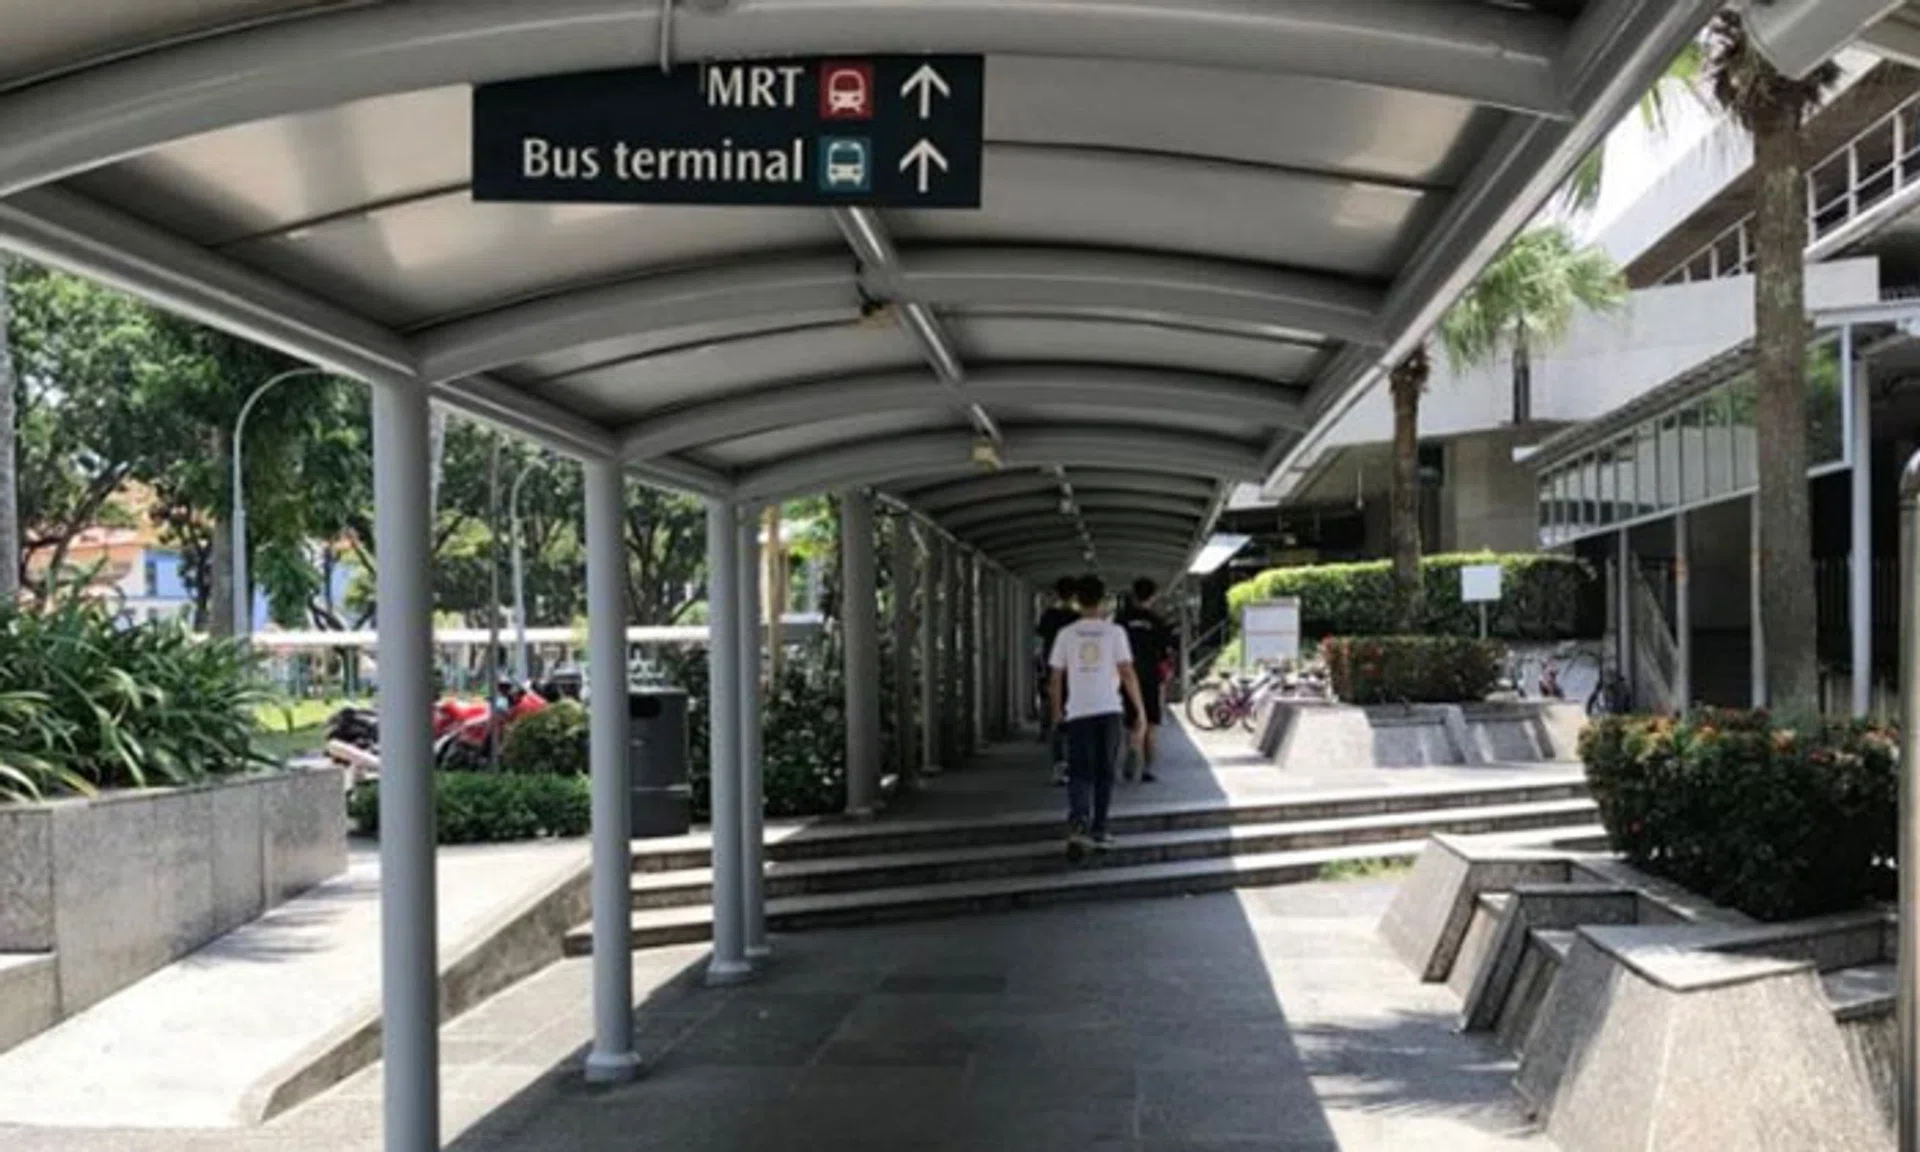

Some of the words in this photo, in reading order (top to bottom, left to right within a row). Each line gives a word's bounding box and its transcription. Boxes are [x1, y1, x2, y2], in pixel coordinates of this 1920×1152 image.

[708, 67, 803, 107] MRT
[523, 138, 600, 179] Bus
[614, 138, 803, 181] terminal
